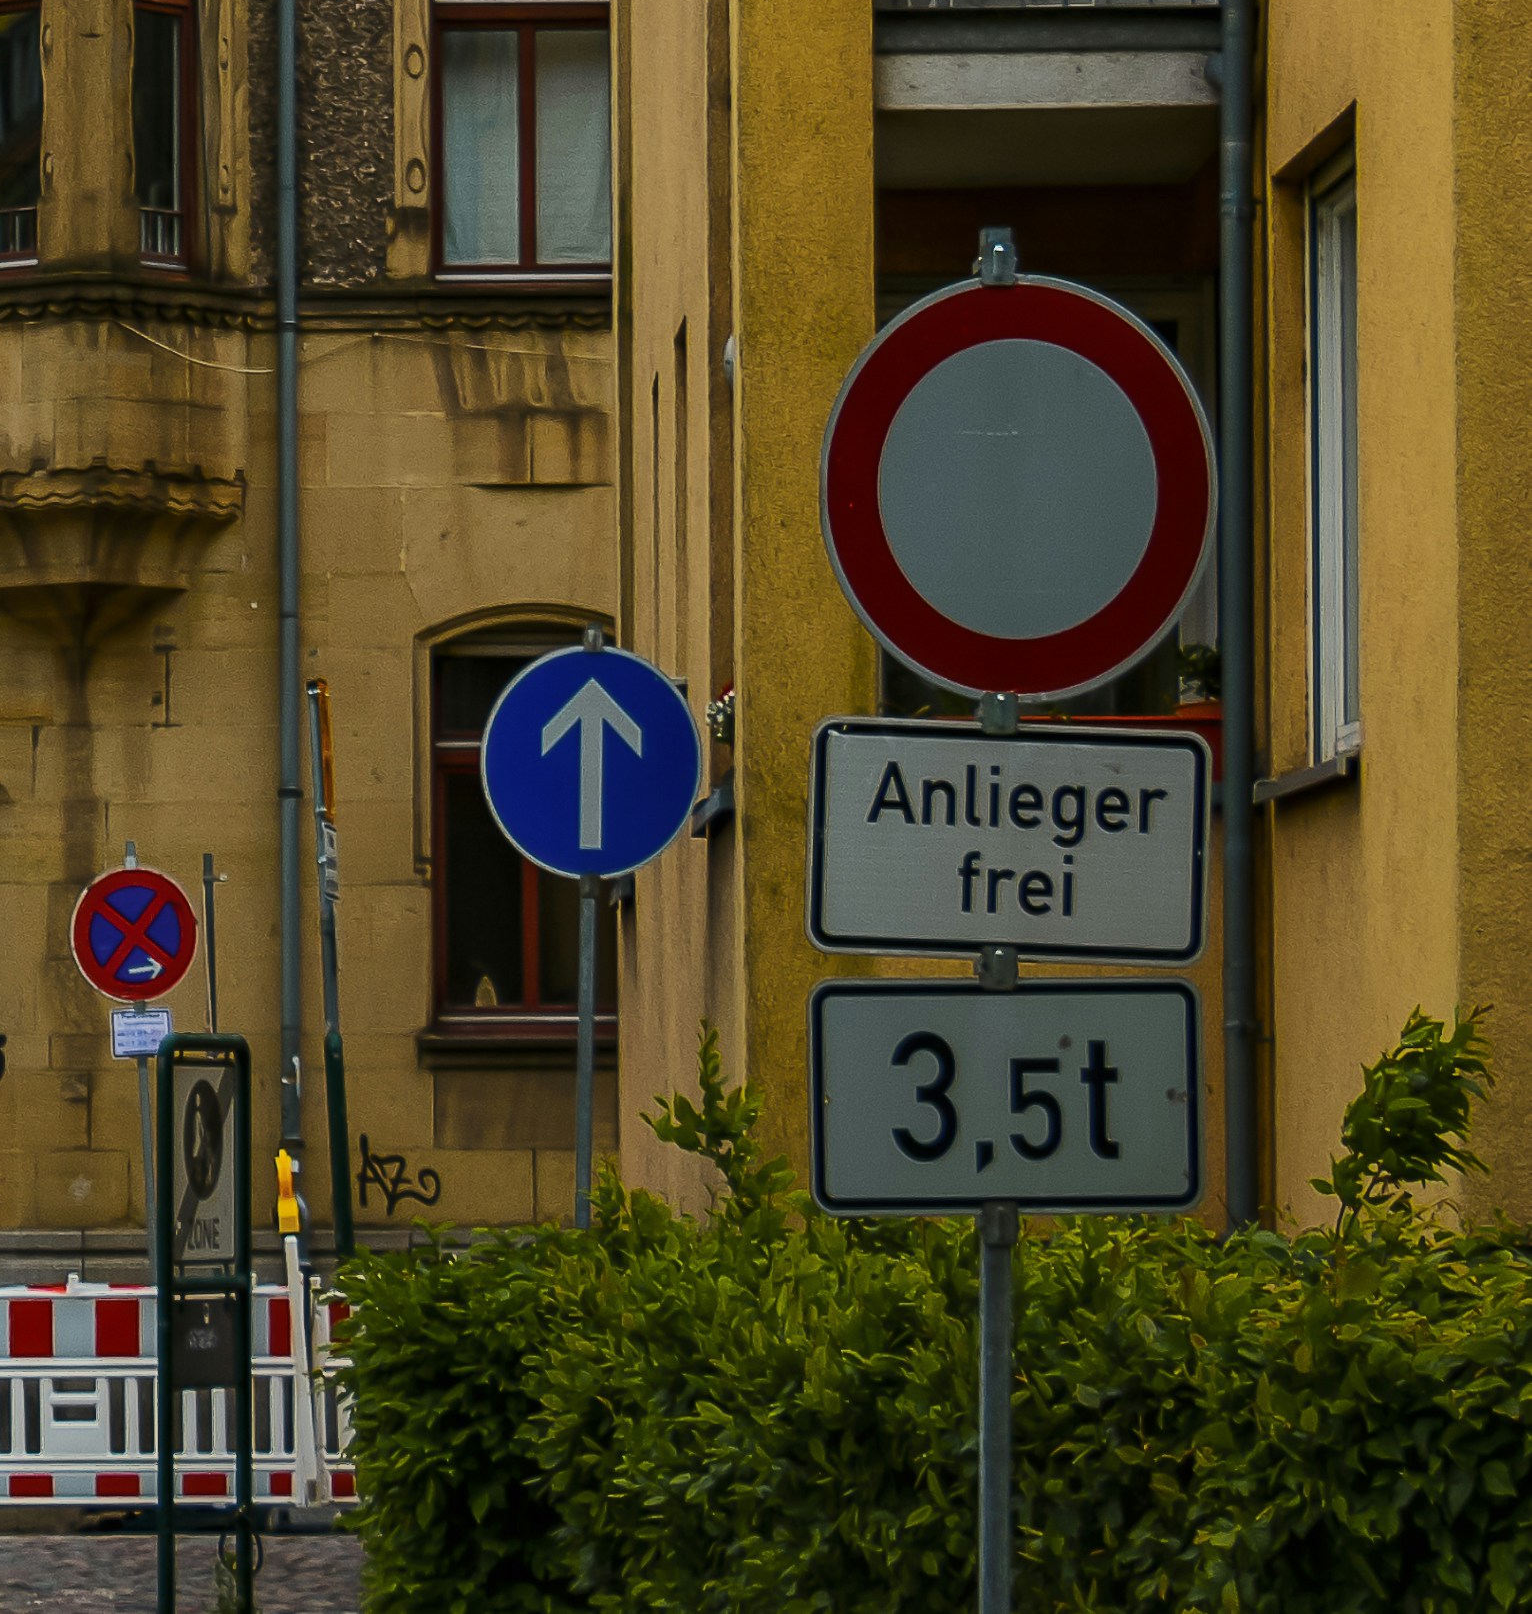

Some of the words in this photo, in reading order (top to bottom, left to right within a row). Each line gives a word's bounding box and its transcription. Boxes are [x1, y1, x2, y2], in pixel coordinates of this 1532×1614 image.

[866, 760, 1169, 848] Anlieger
[957, 850, 1075, 917] frei
[891, 1030, 1120, 1174] 3,5t
